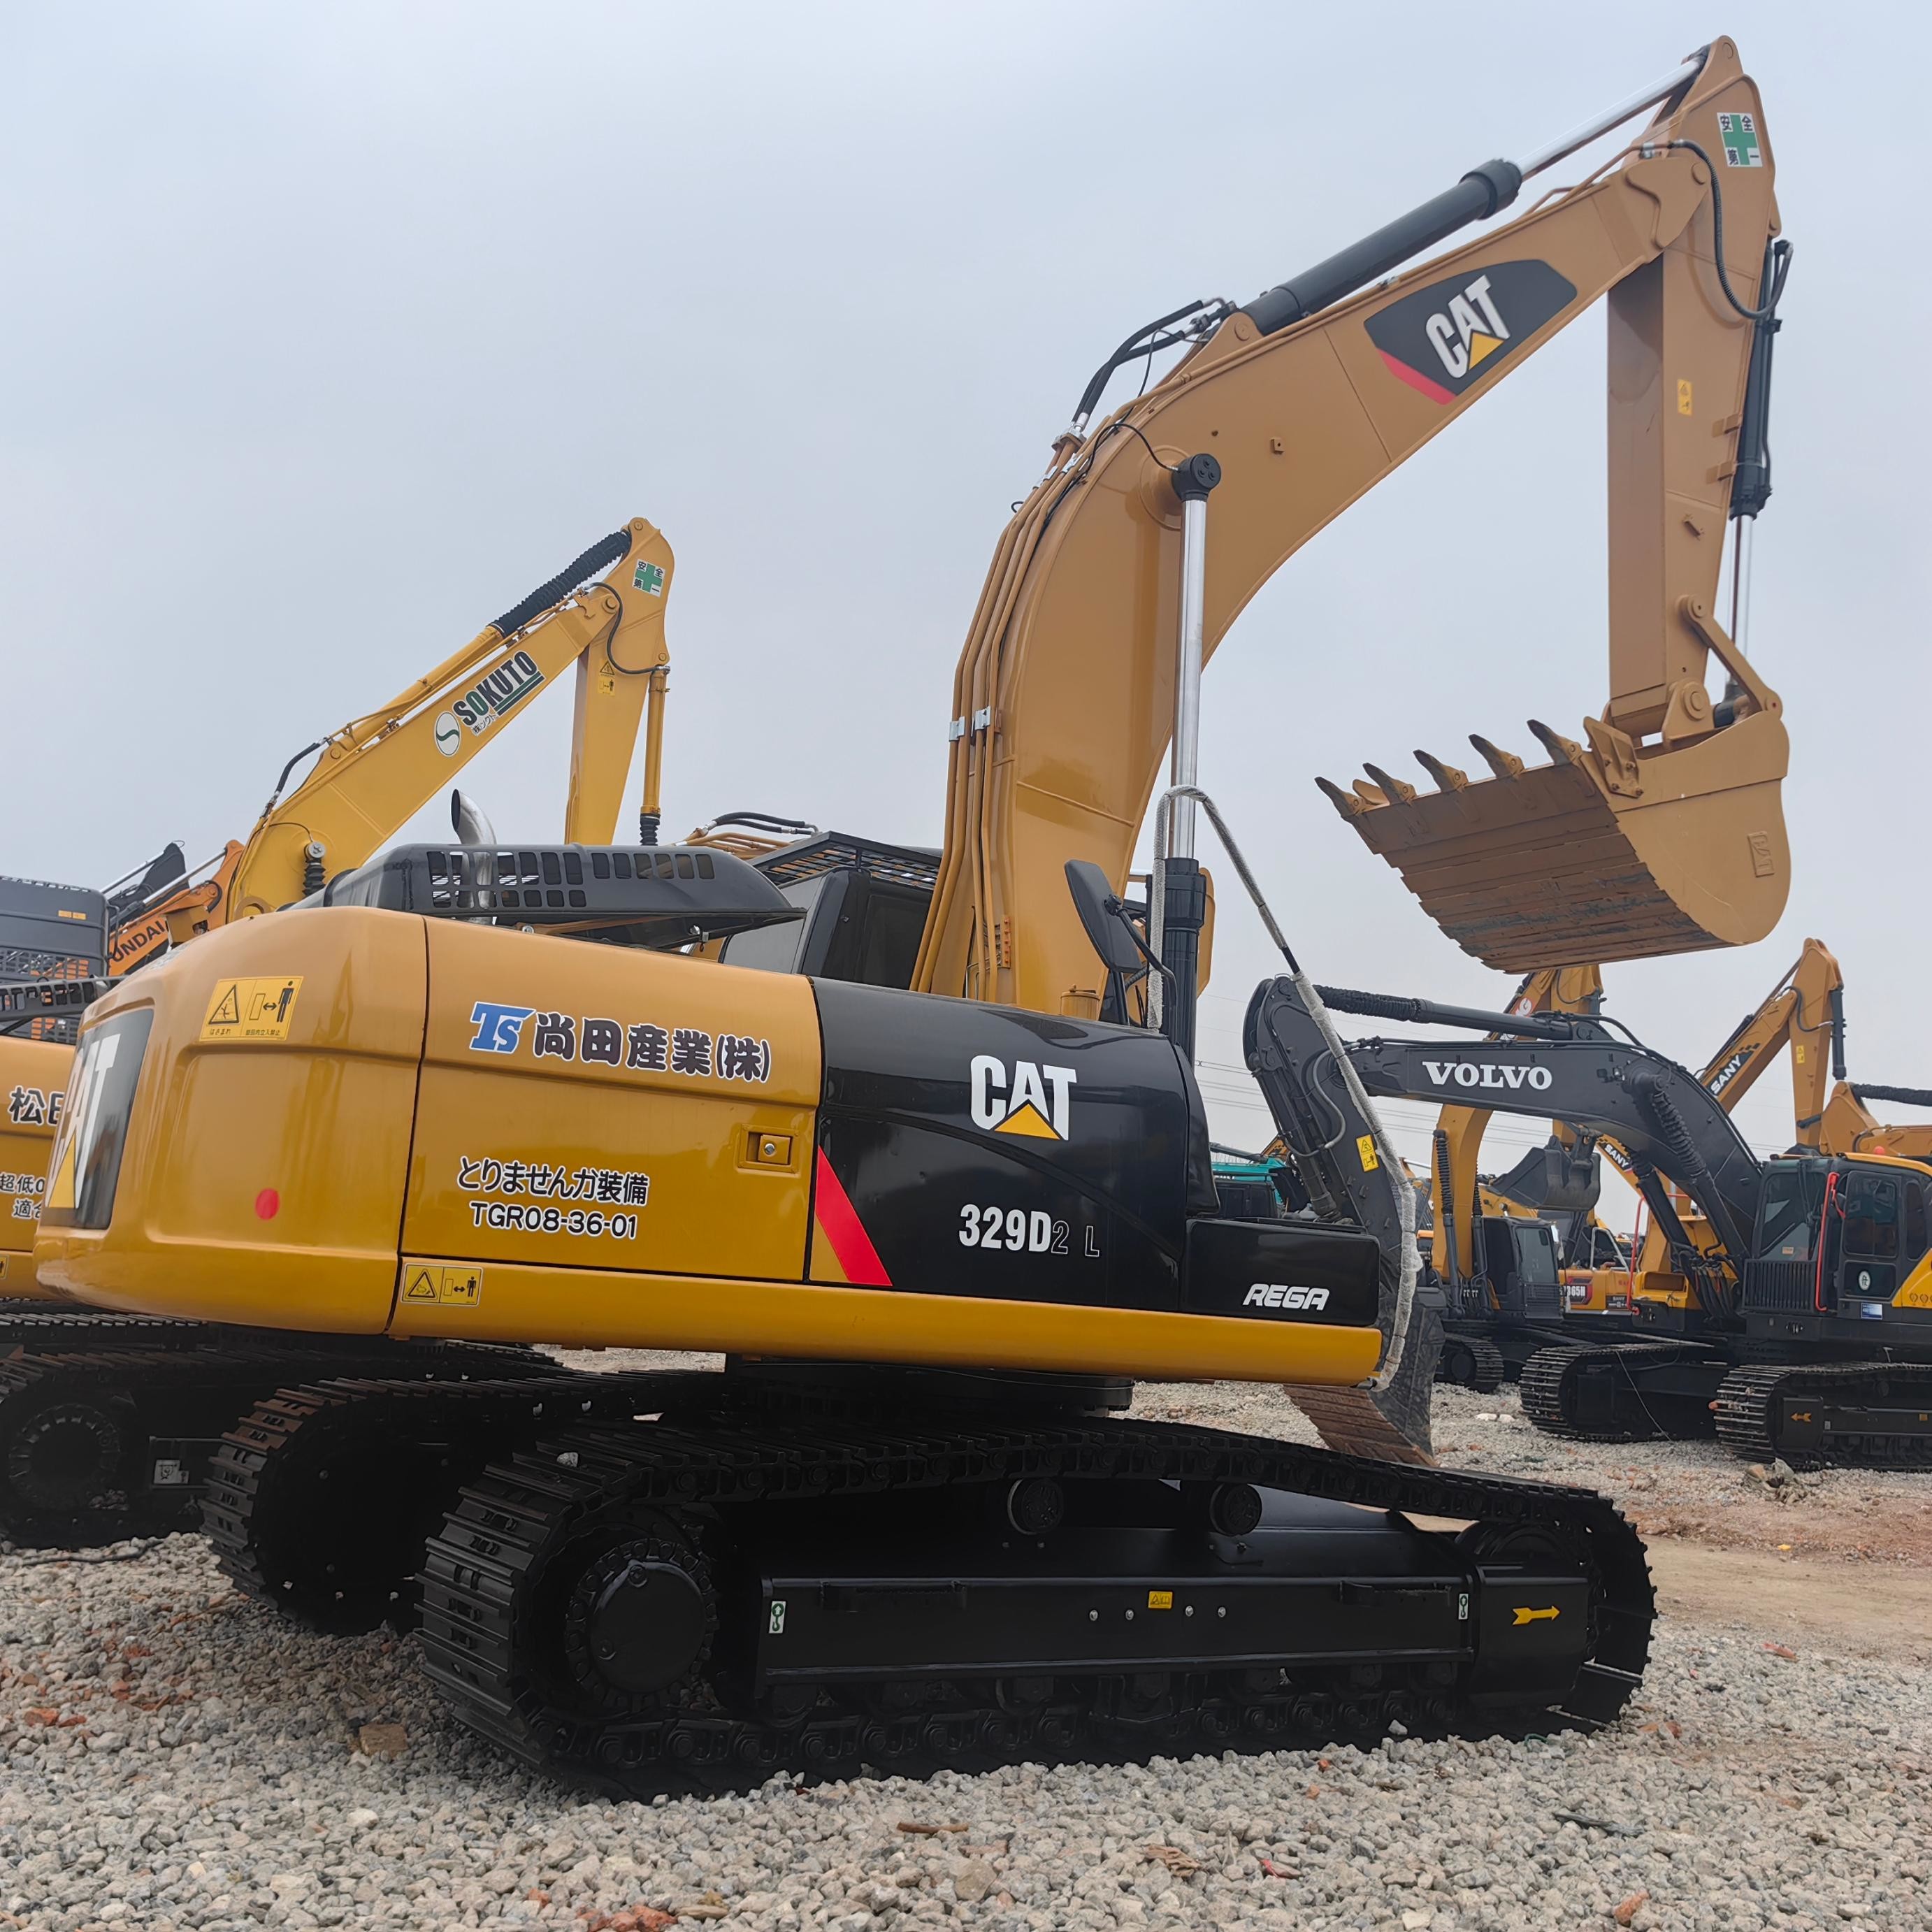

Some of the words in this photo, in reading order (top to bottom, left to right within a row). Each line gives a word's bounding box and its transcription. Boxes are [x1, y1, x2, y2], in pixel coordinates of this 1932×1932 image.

[1426, 274, 1511, 378] CAT
[453, 651, 538, 726] SOKUTO
[111, 921, 166, 963] UNDAI
[1422, 1061, 1552, 1090] VOLVO
[1710, 1054, 1741, 1095] SANY
[970, 1055, 1077, 1141] CAT
[1604, 1144, 1629, 1167] SANY
[458, 1156, 649, 1206] とりませんか装備
[470, 1201, 637, 1239] TGR08-36-01
[1085, 1225, 1100, 1257] L
[1242, 1283, 1330, 1311] REGA
